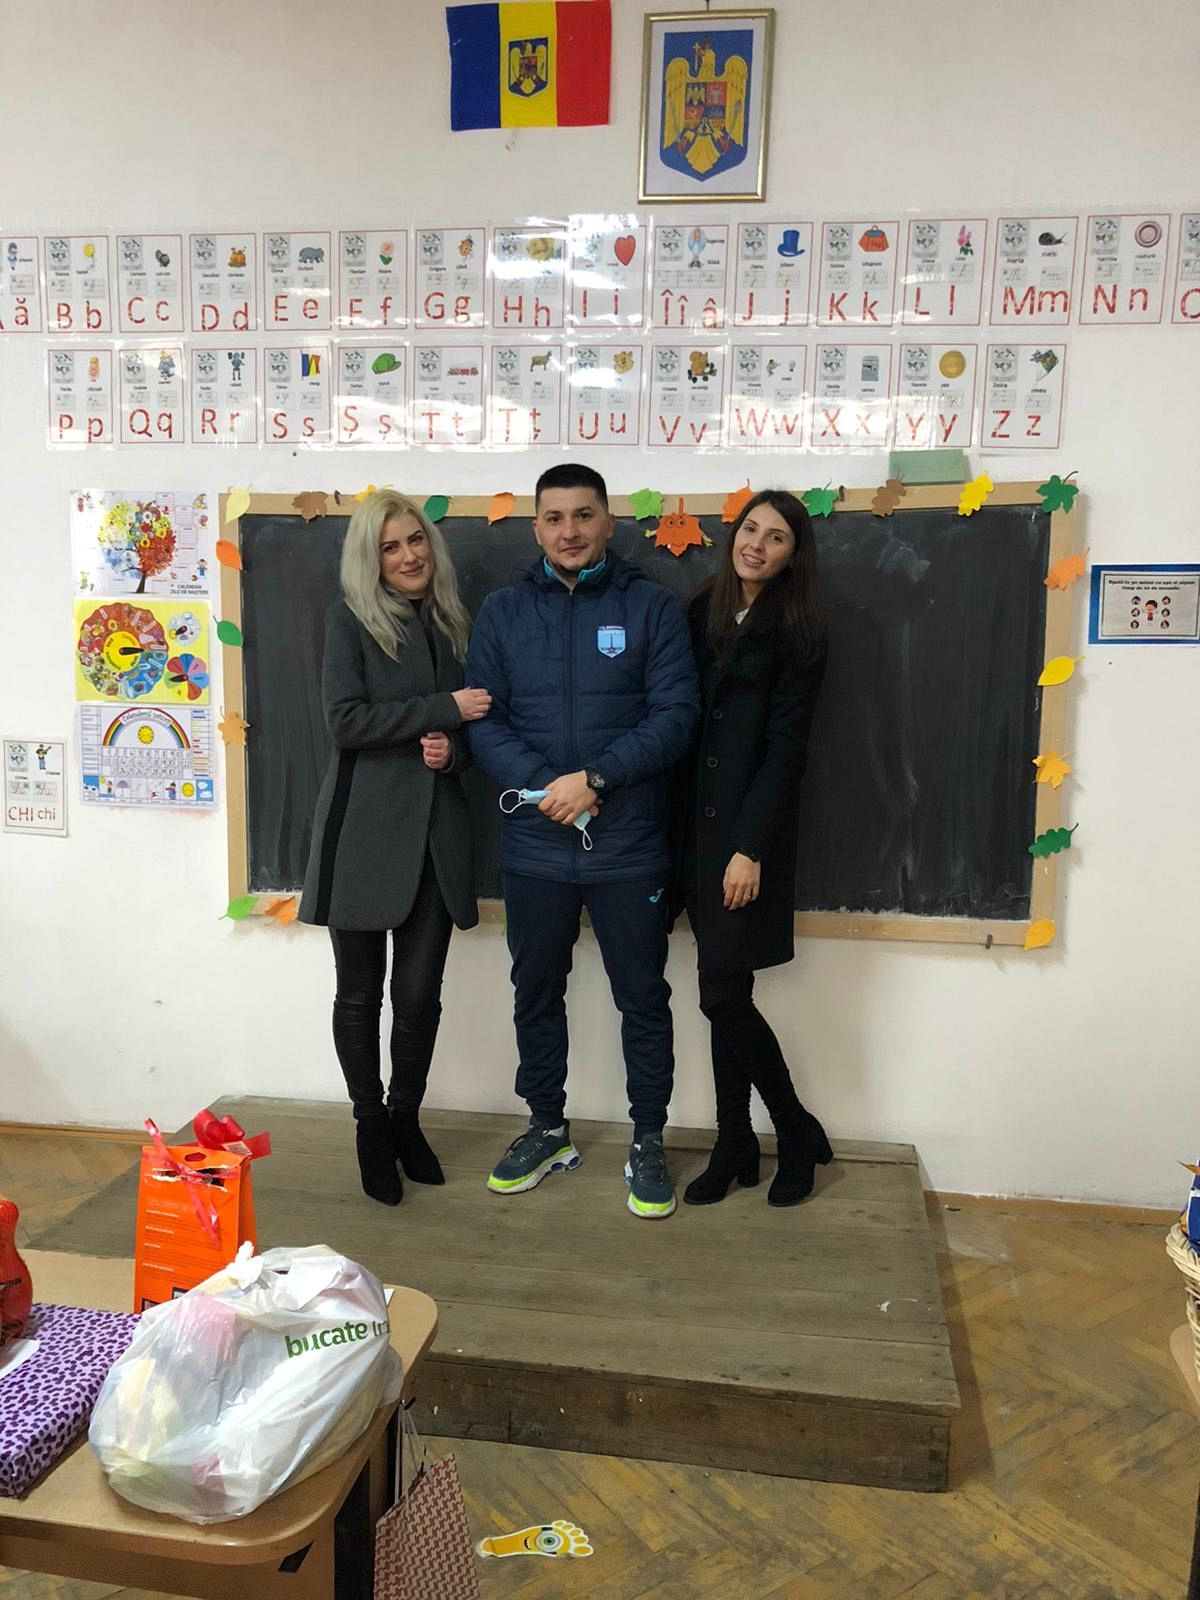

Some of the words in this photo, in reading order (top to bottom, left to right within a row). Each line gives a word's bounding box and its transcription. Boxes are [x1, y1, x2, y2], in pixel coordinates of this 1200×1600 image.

[128, 297, 146, 324] C
[155, 301, 169, 321] c
[274, 295, 288, 322] E
[302, 298, 319, 319] e
[350, 298, 363, 326] F
[380, 297, 392, 326] f
[424, 292, 445, 320] G
[454, 296, 470, 323] g
[503, 296, 523, 323] H
[534, 297, 551, 327] h
[614, 289, 619, 315] i
[661, 289, 674, 325] Î
[677, 296, 688, 325] î
[702, 297, 717, 328] â
[743, 293, 754, 320] J
[780, 290, 790, 325] j
[829, 292, 848, 320] K
[863, 292, 878, 321] k
[915, 287, 930, 315] L
[1093, 284, 1117, 313] N
[1129, 288, 1149, 311] n
[57, 302, 72, 329] B
[86, 301, 102, 329] b
[201, 304, 220, 330] D
[232, 302, 249, 330] d
[59, 414, 73, 439] P
[88, 415, 104, 443] p
[157, 412, 172, 439] q
[201, 409, 217, 435] R
[230, 411, 240, 432] r
[273, 413, 288, 439] S
[302, 417, 314, 436] s
[422, 412, 440, 439] T
[452, 412, 464, 436] t
[579, 412, 599, 439] U
[610, 412, 626, 434] u
[659, 416, 681, 443] V
[690, 422, 708, 443] v
[905, 414, 925, 440] Y
[939, 414, 958, 442] y
[991, 410, 1010, 438] Z
[1027, 415, 1041, 436] z
[8, 806, 34, 822] CHI
[38, 807, 56, 821] chi
[284, 1320, 369, 1359] bucate
